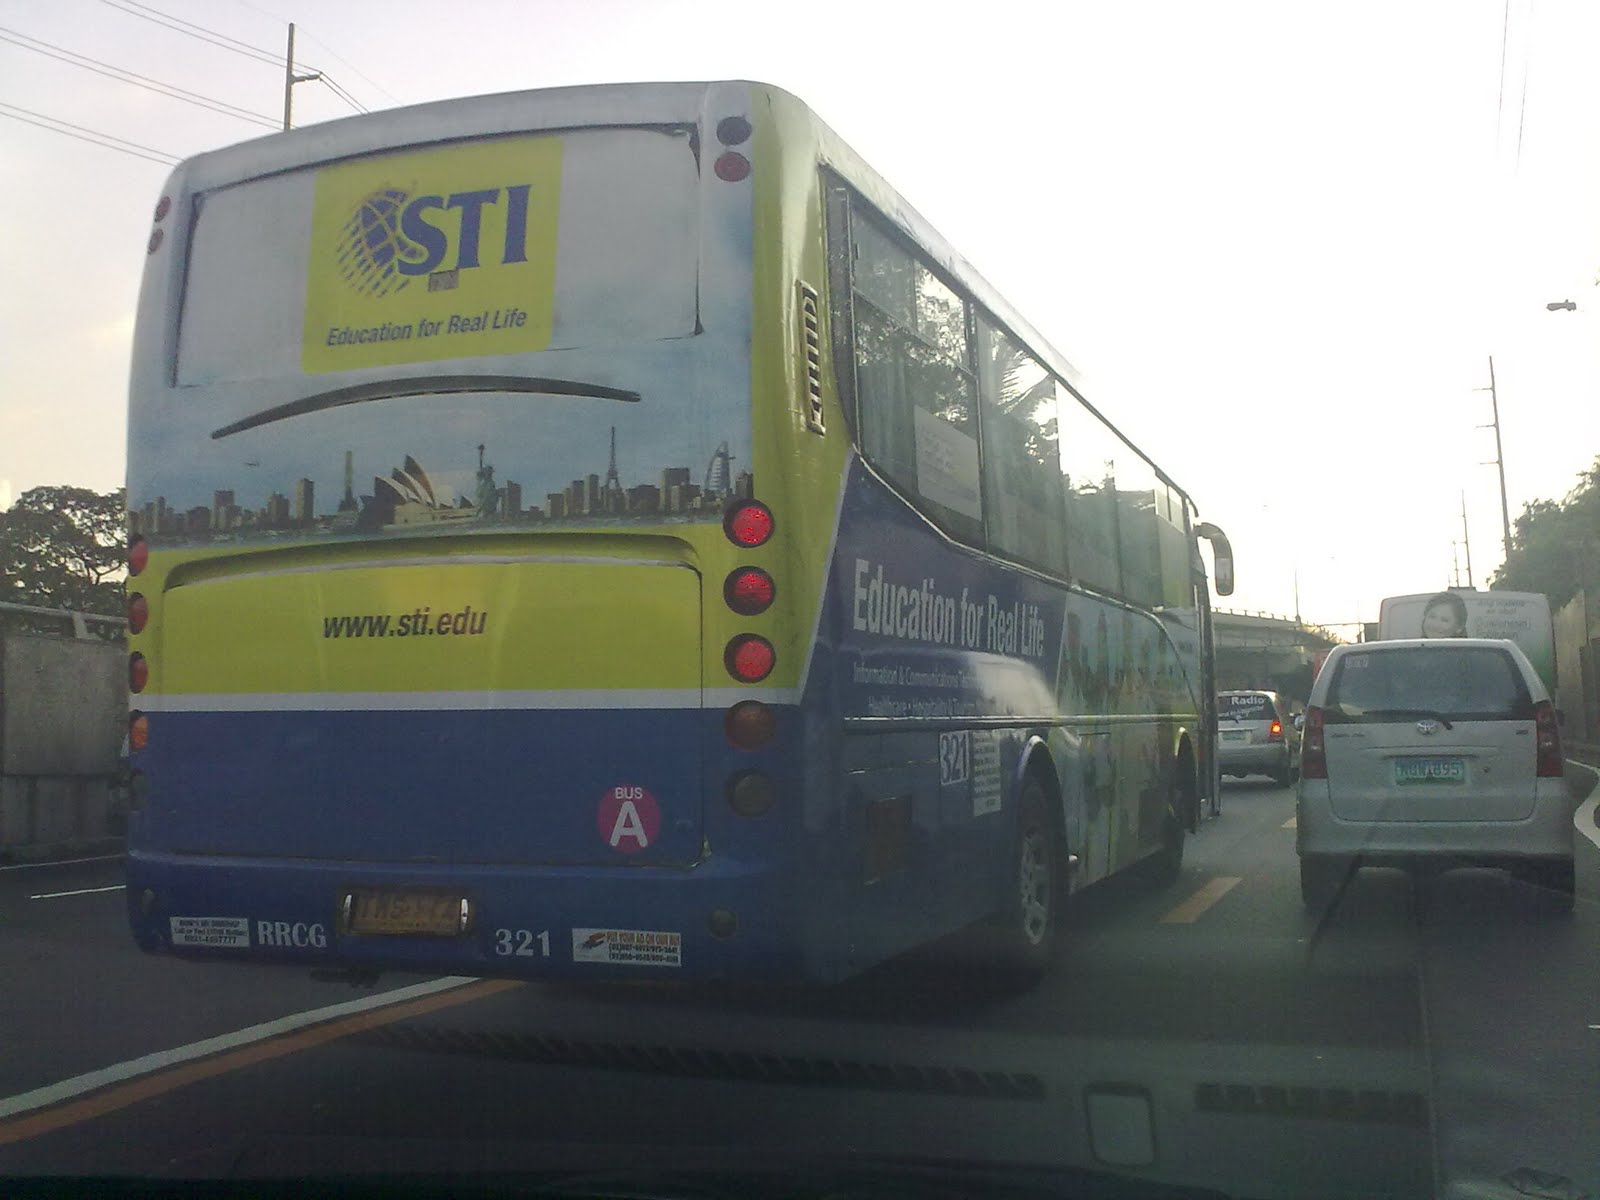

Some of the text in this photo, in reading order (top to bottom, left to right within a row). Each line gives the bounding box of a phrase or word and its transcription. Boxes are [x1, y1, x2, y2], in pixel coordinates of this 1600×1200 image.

[397, 184, 532, 276] STI
[326, 308, 528, 347] Education for Real Life
[322, 605, 487, 638] www.sti.edu
[853, 558, 1045, 657] Education for Real Life
[1231, 696, 1265, 705] Radio
[615, 787, 643, 799] BUS
[610, 800, 648, 847] A
[257, 920, 327, 948] RRCG
[495, 928, 551, 957] 321
